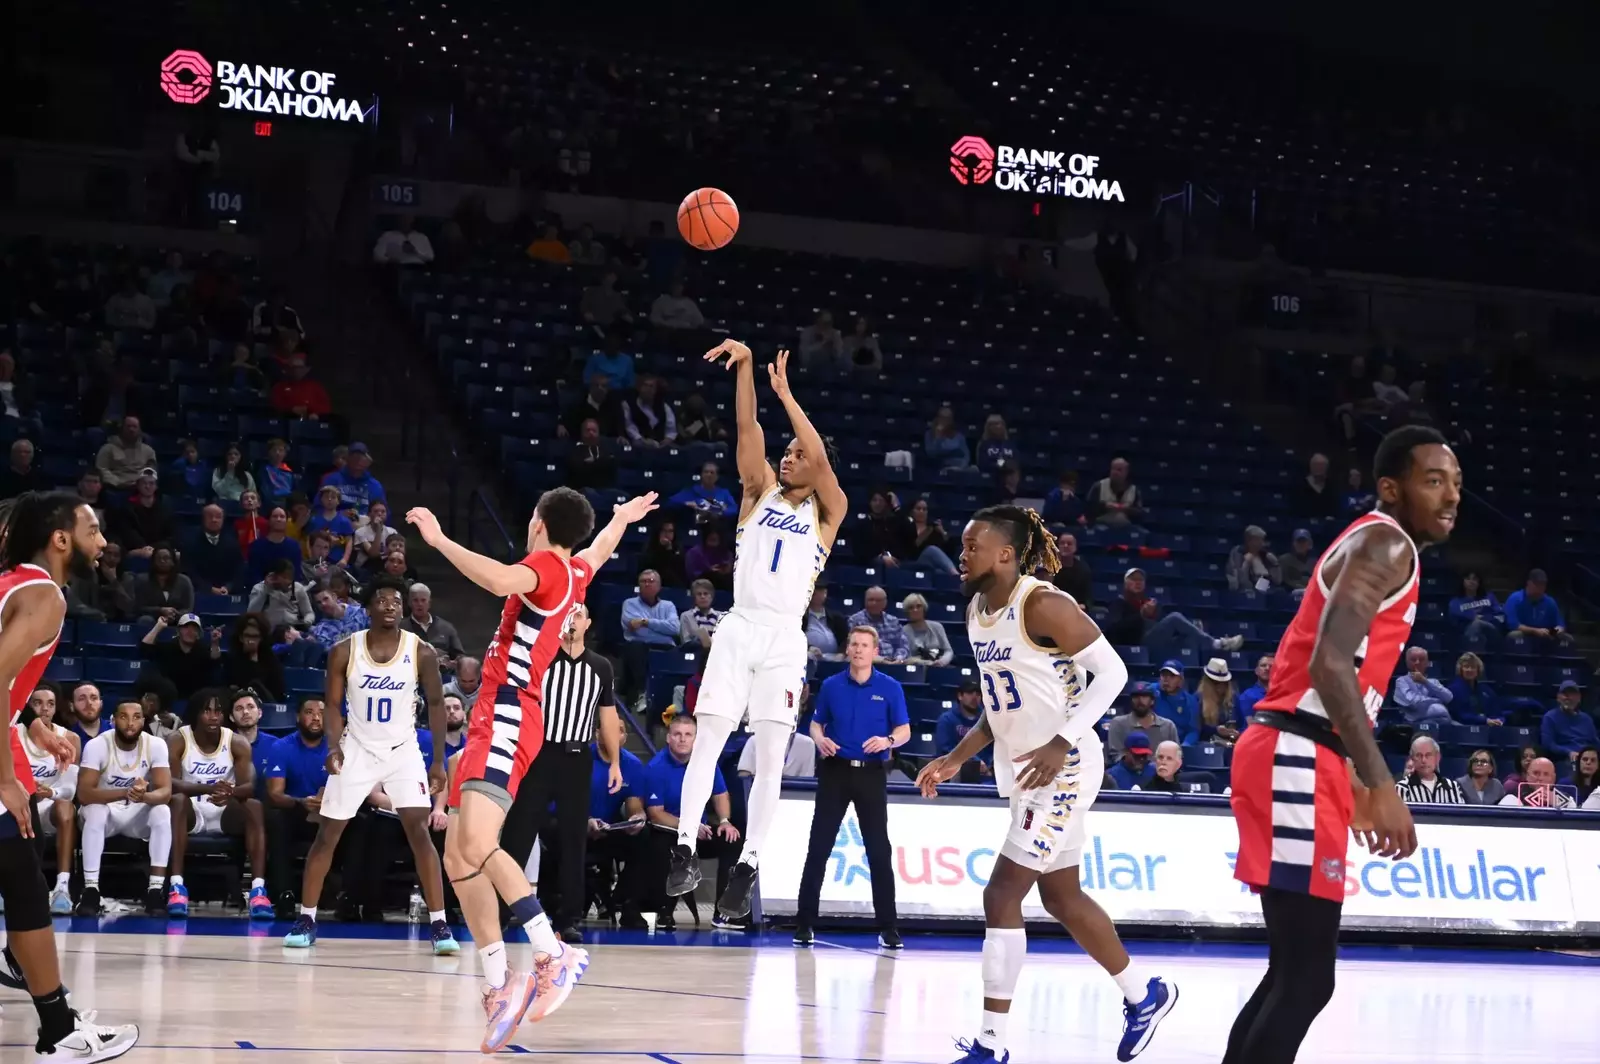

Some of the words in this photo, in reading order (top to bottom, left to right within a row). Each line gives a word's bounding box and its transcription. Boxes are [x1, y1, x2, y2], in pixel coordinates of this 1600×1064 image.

[217, 61, 295, 91] BANK
[300, 70, 336, 95] OF
[255, 122, 272, 136] EXIT
[998, 145, 1065, 172] BANK
[1069, 154, 1100, 176] OF
[207, 190, 242, 212] 104
[381, 184, 413, 204] 105
[1271, 295, 1300, 314] 106
[758, 507, 810, 535] Tulsa
[770, 538, 783, 573] 1
[973, 639, 1012, 663] Tulsa
[358, 674, 406, 690] Tulsa
[983, 669, 1022, 712] 33
[366, 696, 392, 723] 10
[189, 761, 228, 775] Tulsa
[107, 775, 136, 788] Tul
